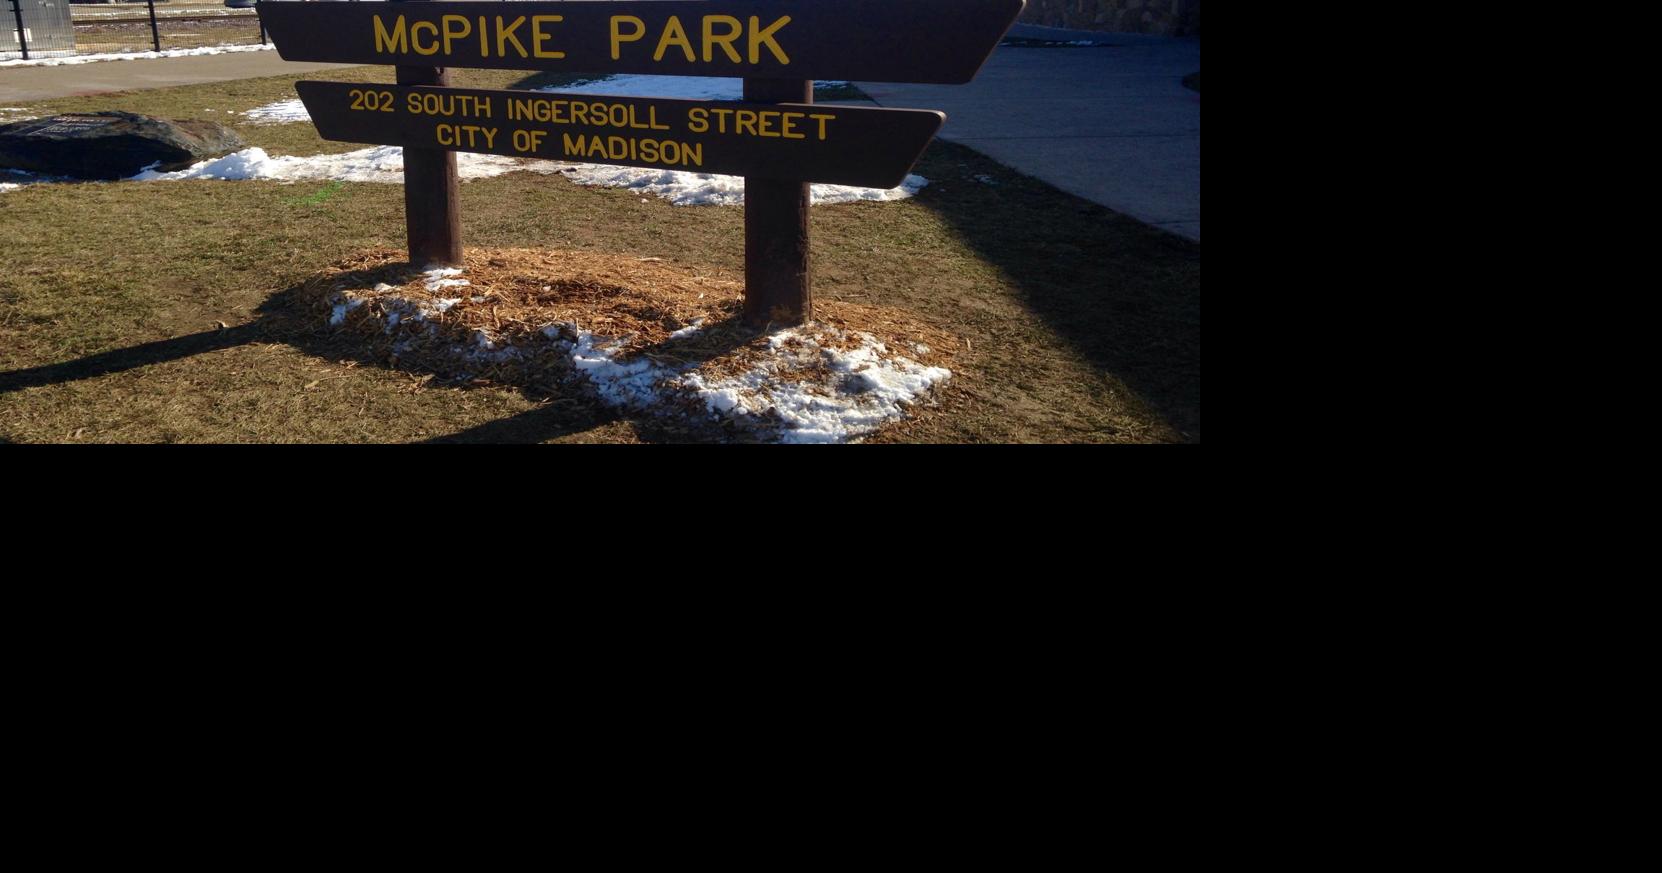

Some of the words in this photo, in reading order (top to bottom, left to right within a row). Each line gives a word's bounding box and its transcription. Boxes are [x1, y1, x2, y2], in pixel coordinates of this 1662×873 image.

[373, 14, 565, 59] McPIKE
[610, 14, 791, 65] PARK
[350, 89, 394, 112] 202
[407, 92, 491, 116] SOUTH
[507, 99, 669, 130] INGERSOLL
[688, 107, 835, 140] STREET
[436, 124, 498, 149] CITY
[513, 129, 546, 152] OF
[563, 133, 702, 166] MADISON
